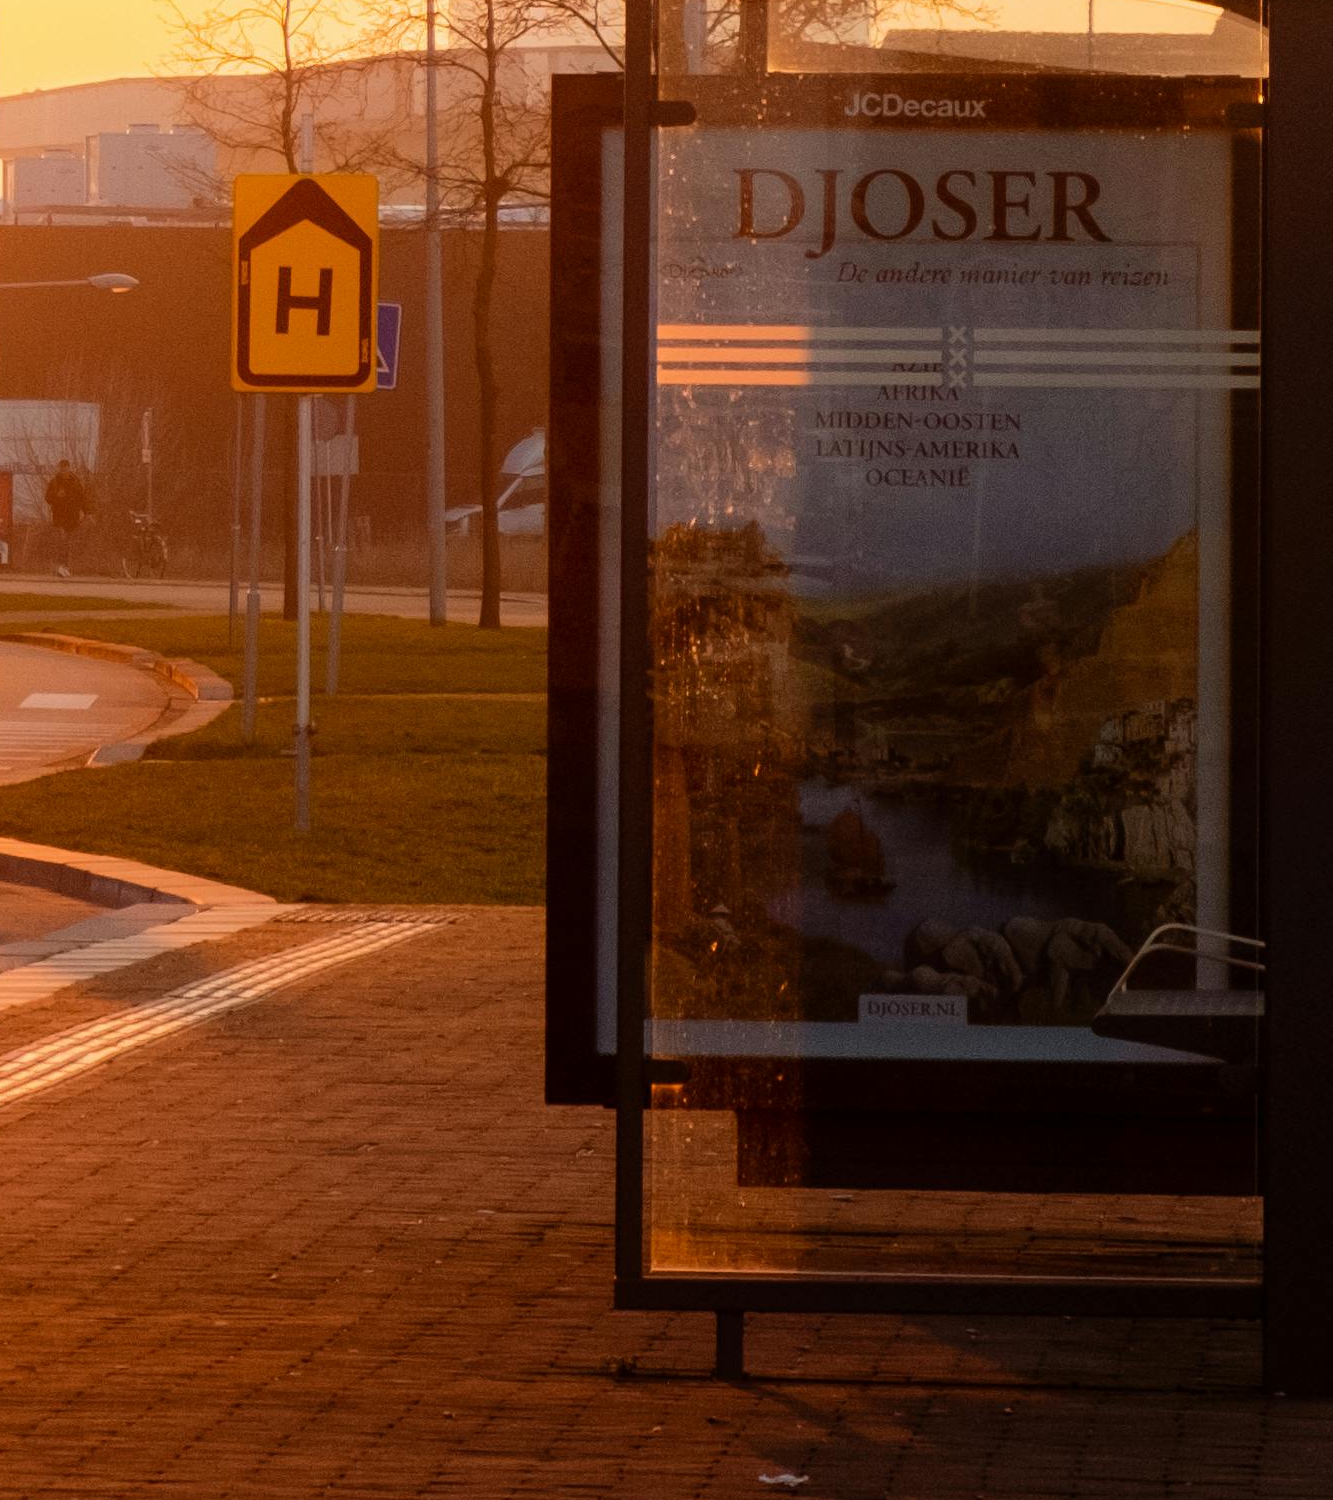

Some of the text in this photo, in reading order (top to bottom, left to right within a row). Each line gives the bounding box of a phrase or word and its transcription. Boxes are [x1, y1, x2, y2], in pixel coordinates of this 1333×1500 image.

[844, 93, 986, 118] JCDecaux
[734, 168, 1113, 258] DJOSER
[837, 261, 1172, 287] De andere manier van reizen
[275, 266, 333, 336] H
[876, 385, 960, 401] AFRIKA
[816, 410, 1021, 431] MIDDEN-OOSTEN
[816, 439, 1020, 462] LATIJNS-AMERIKA
[865, 466, 971, 488] OCEANIË
[867, 1000, 961, 1017] DJOSER.NL
